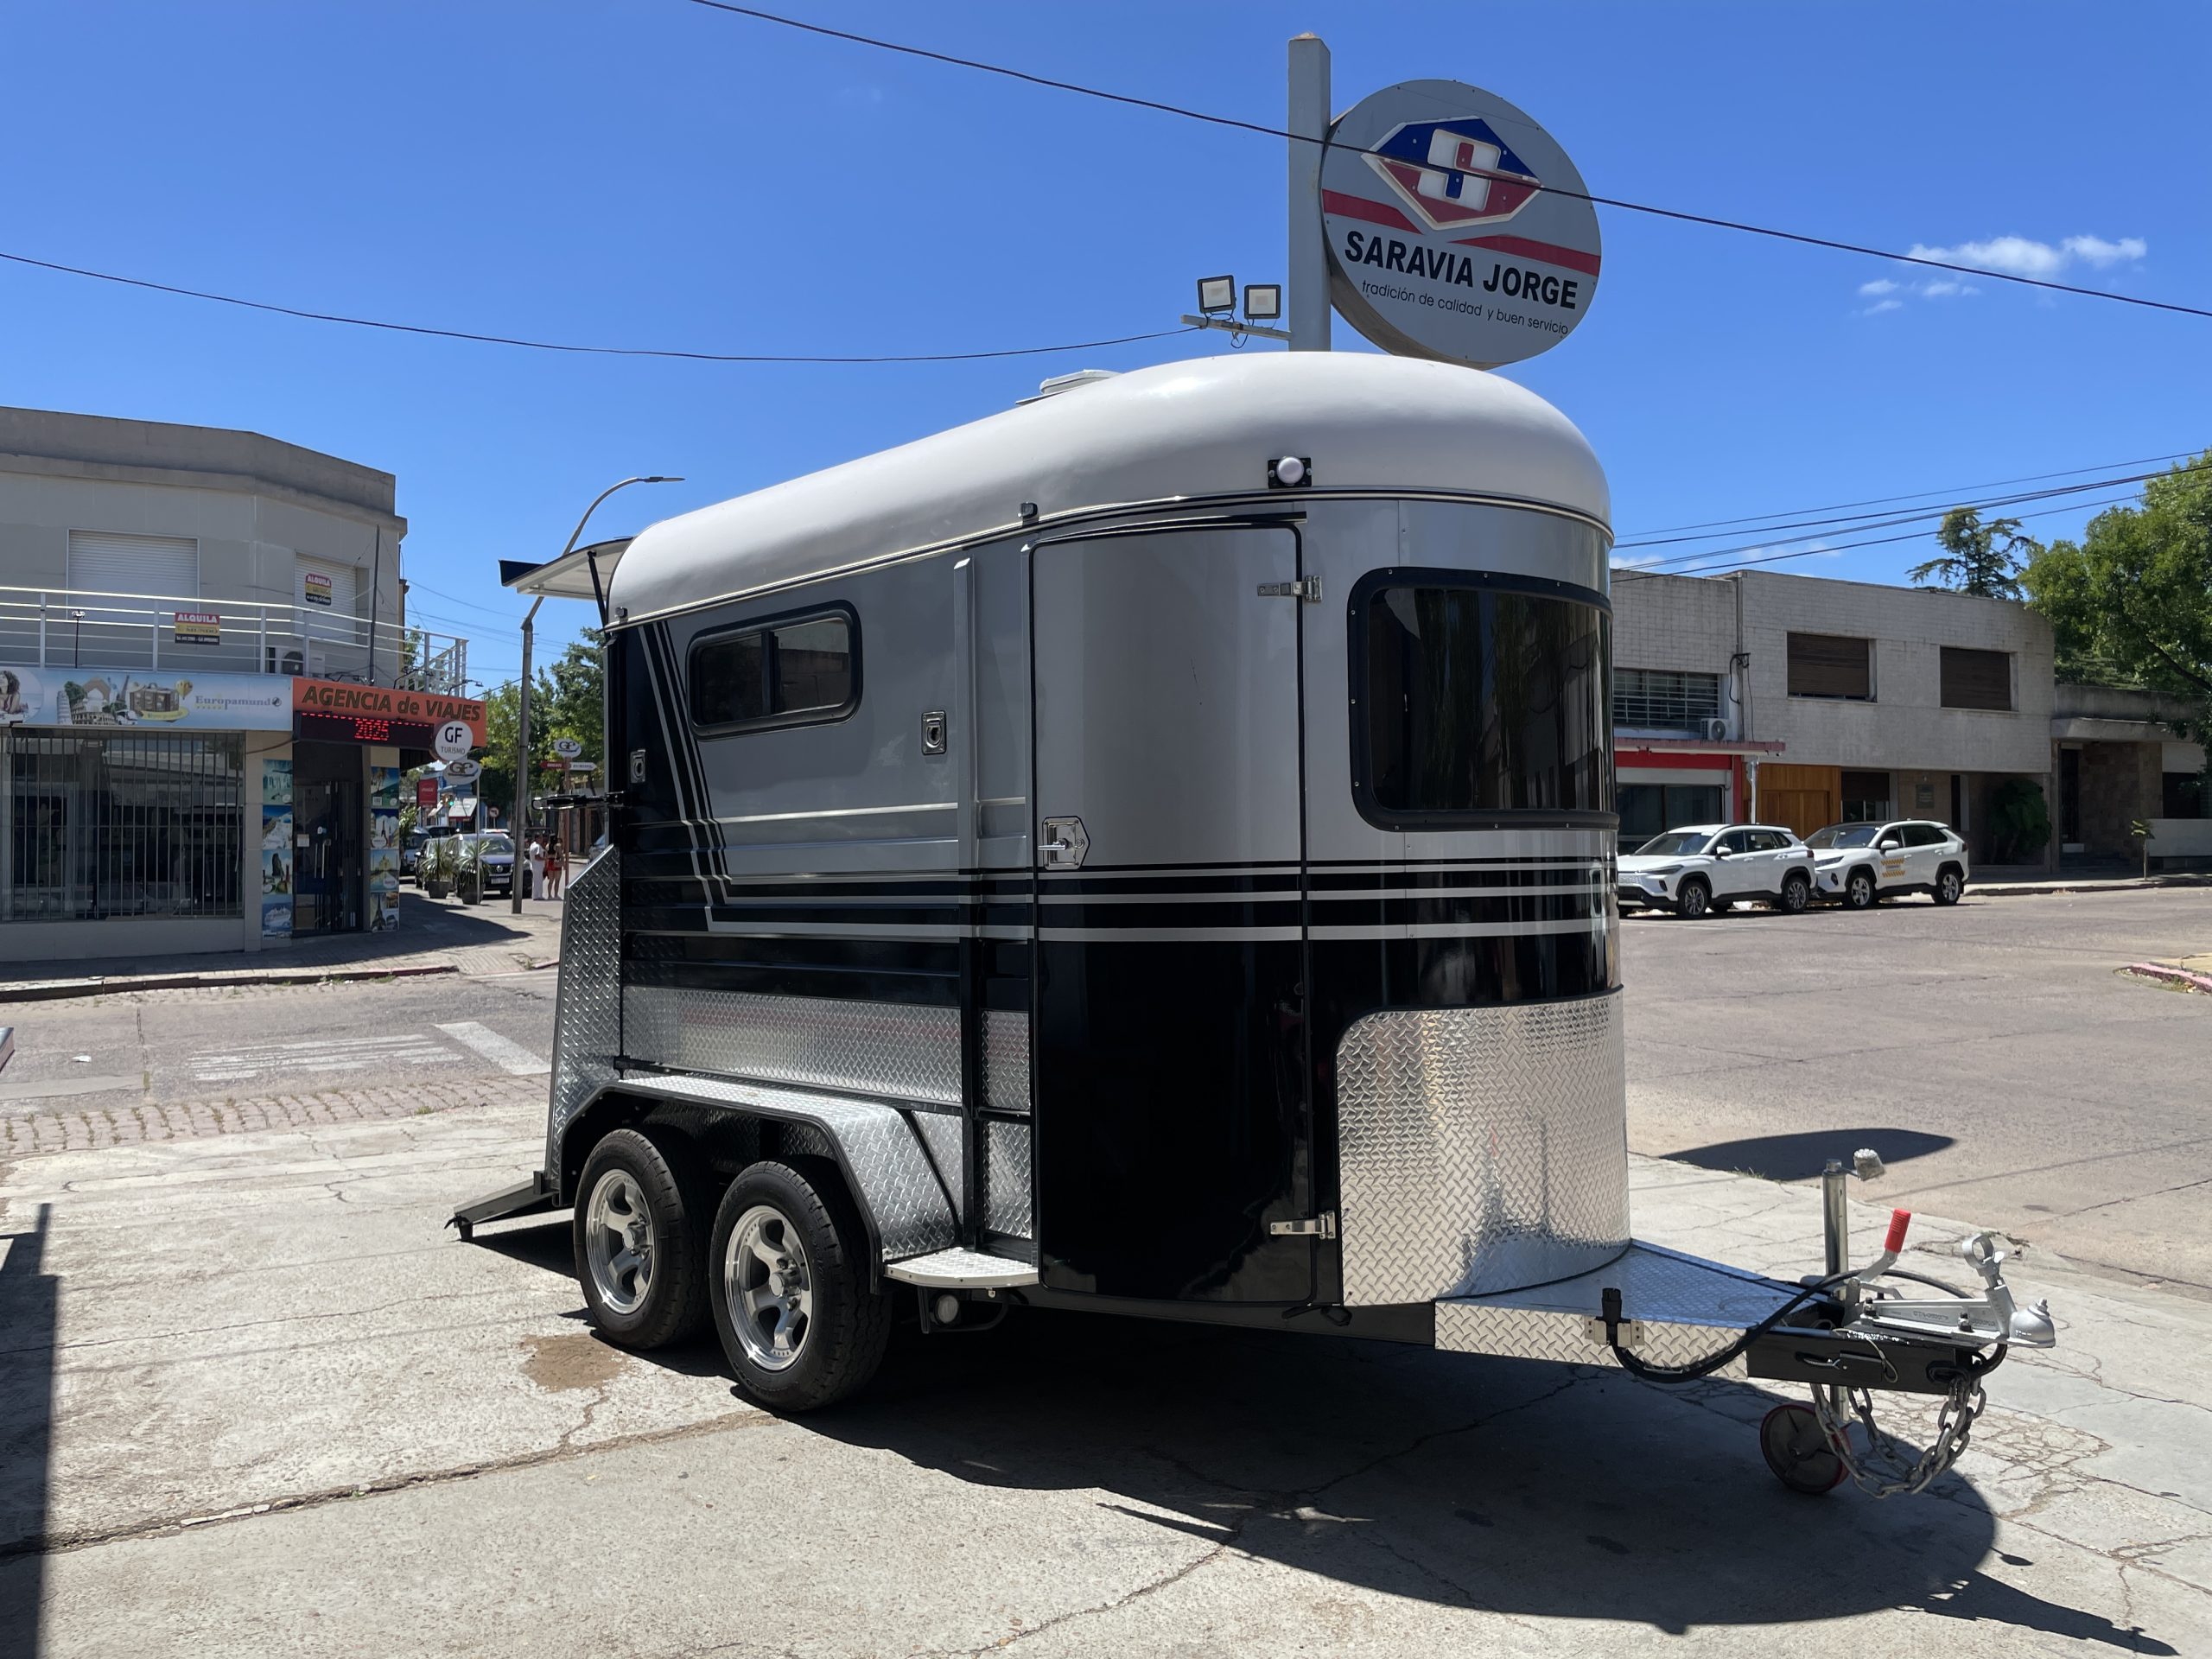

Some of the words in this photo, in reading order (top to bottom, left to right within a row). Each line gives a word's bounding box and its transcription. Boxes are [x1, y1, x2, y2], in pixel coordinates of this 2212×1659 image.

[1344, 230, 1473, 288] SARAVIA
[1483, 264, 1578, 309] JORGE
[1362, 280, 1415, 302] tradición
[1419, 293, 1434, 307] de
[1437, 298, 1483, 316] calidad
[1487, 308, 1494, 321] y
[1496, 308, 1525, 326] buen
[1527, 317, 1569, 335] servicio
[307, 575, 332, 588] ALQUILA
[177, 613, 218, 623] ALQUILA
[302, 685, 391, 713] AGENCIA
[397, 696, 420, 716] de
[426, 700, 481, 722] VIAJES
[354, 721, 390, 741] 2025
[444, 727, 463, 743] GF
[441, 746, 466, 759] TURISMO
